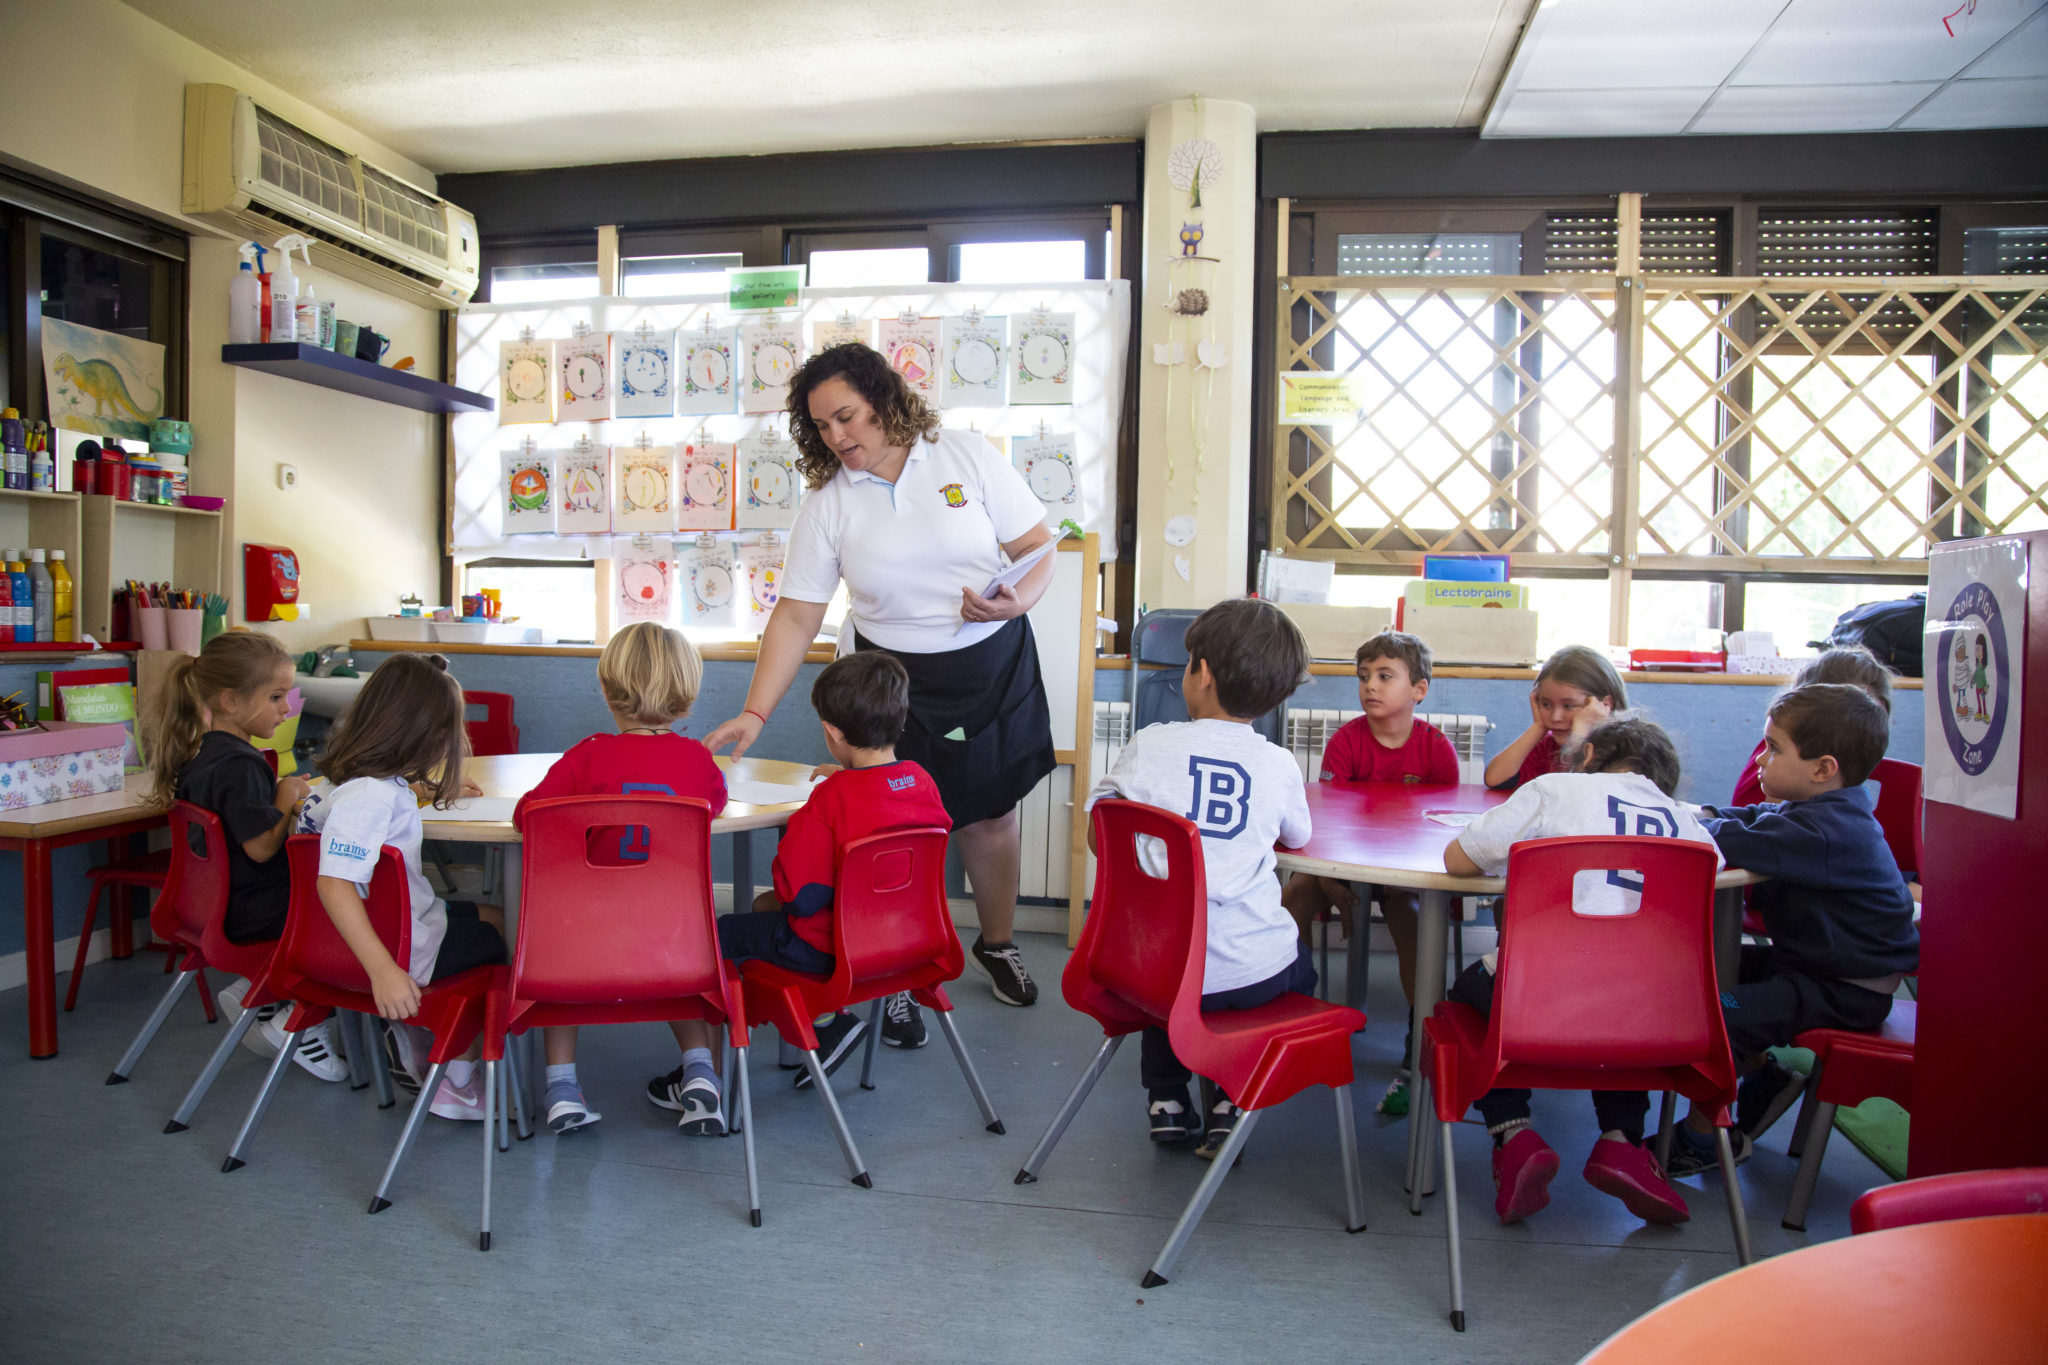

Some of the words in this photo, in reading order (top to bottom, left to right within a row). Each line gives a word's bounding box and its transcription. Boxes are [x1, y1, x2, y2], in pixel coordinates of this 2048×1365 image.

[752, 292, 776, 300] gallery
[1435, 588, 1513, 599] Lectobrains
[1953, 591, 1974, 624] Role
[1976, 589, 1995, 625] Play
[83, 702, 119, 713] MUNDO
[1962, 742, 1983, 765] Zone
[1185, 754, 1252, 840] B
